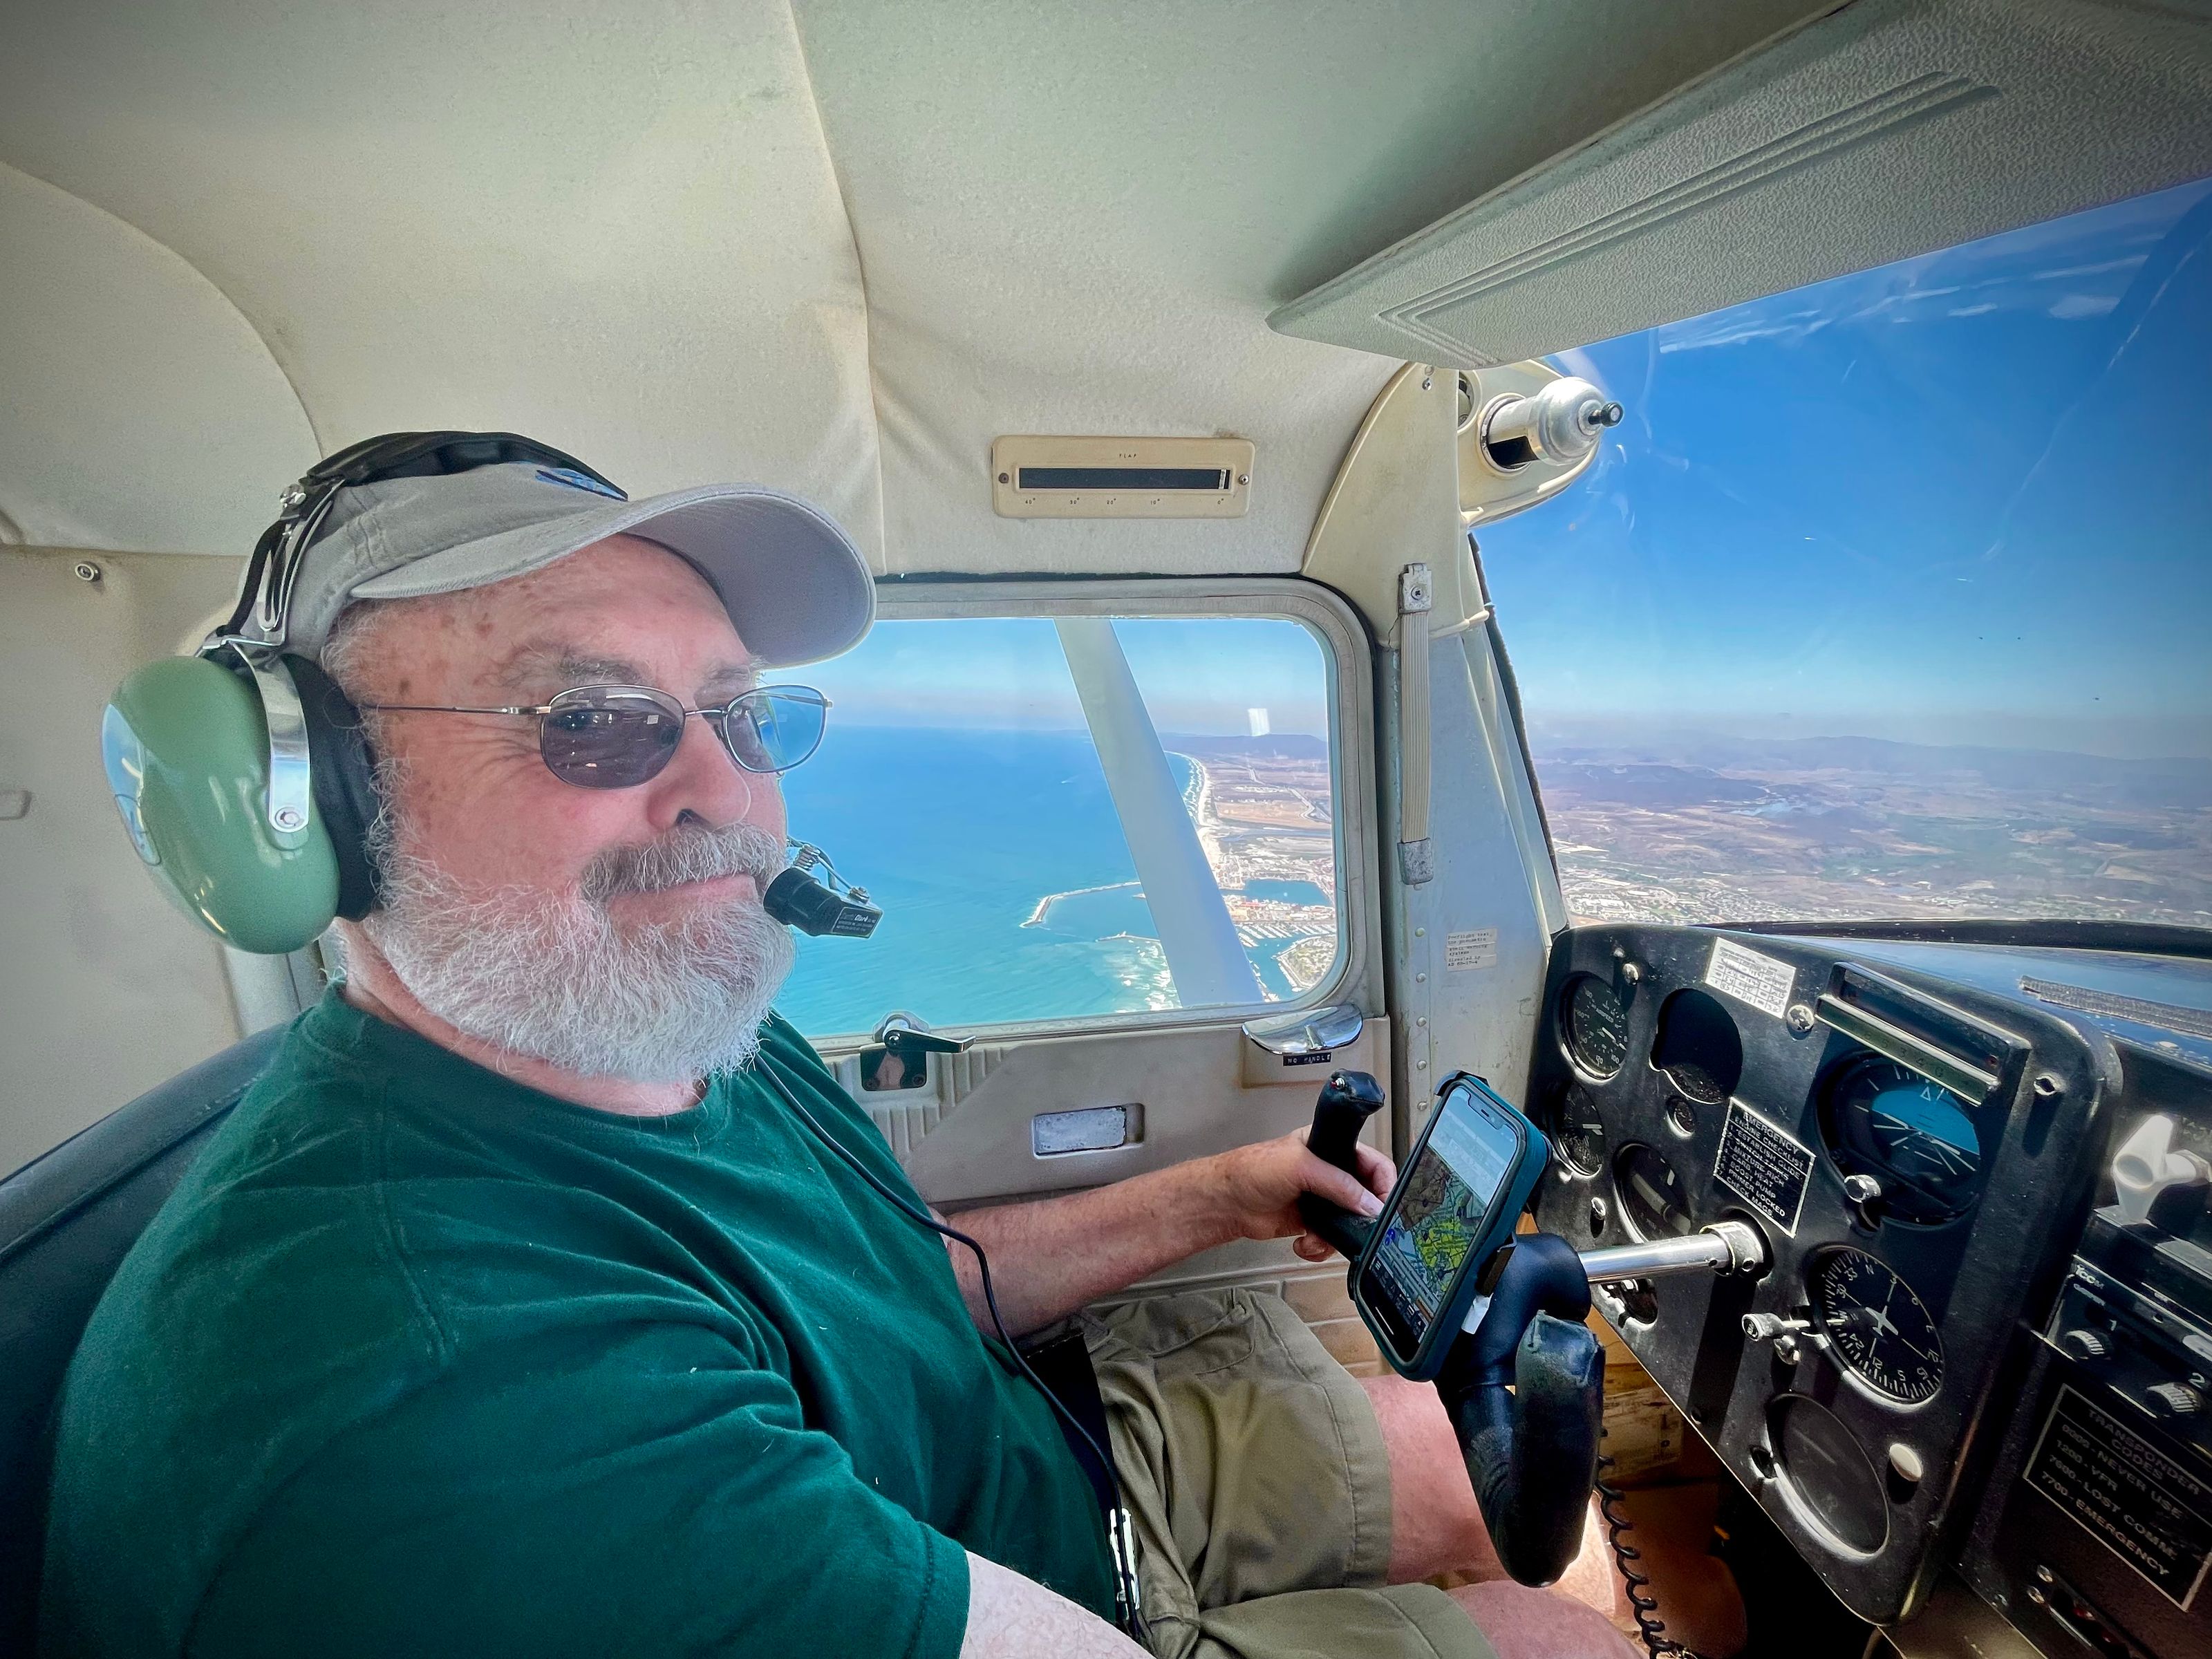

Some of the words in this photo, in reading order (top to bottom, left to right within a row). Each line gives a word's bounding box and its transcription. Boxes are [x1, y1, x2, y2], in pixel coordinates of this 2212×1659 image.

[1738, 1131, 1775, 1161] ESTABLISH
[1743, 1112, 1797, 1154] EMERGENCY
[1734, 1145, 1764, 1172] MIXTURE
[1766, 1170, 1784, 1186] RICH
[1763, 1137, 1803, 1168] CHECKLIST
[1727, 1177, 1748, 1197] CHECK
[1729, 1169, 1754, 1191] PRIMER
[1756, 1191, 1785, 1216] LOCKED
[1730, 1161, 1752, 1181] BOOST
[1755, 1181, 1775, 1199] PUMP
[1754, 1170, 1772, 1187] HEAT
[2188, 1372, 2206, 1389] 2
[2088, 1409, 2200, 1495] TRANSPONDER
[2111, 1438, 2163, 1480] CODES
[2090, 1466, 2117, 1490] VFR
[2097, 1451, 2146, 1491] NEVER
[2150, 1491, 2183, 1519] USE
[2083, 1482, 2119, 1514] LOST
[2041, 1471, 2068, 1496] 7700
[2076, 1499, 2169, 1578] EMERGENCY
